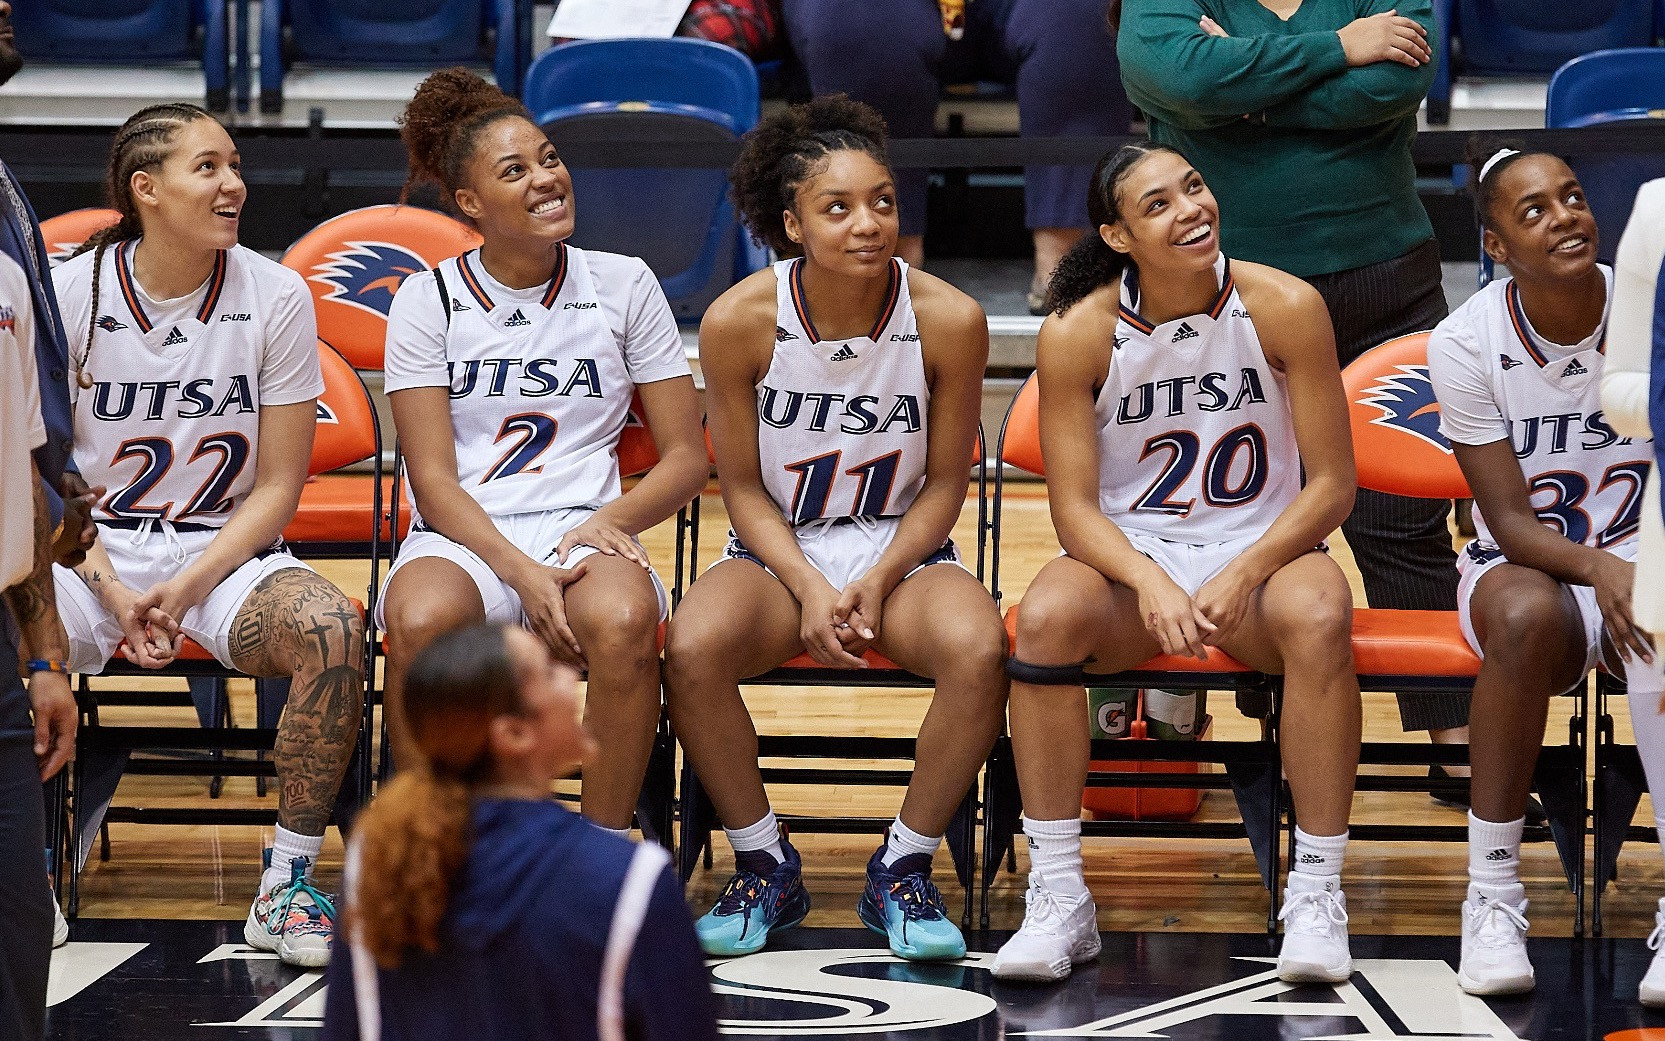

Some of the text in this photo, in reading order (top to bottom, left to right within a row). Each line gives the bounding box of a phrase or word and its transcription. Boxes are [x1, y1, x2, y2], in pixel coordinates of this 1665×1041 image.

[161, 336, 188, 347] adidas
[1171, 330, 1199, 343] adidas
[448, 358, 604, 399] UTSA
[1117, 367, 1268, 425] UTSA
[1560, 366, 1588, 378] adidas
[92, 374, 256, 422] UTSA
[760, 386, 922, 435] UTSA
[478, 411, 558, 485] 2
[1510, 410, 1655, 460] UTS
[101, 431, 250, 521] 22
[784, 449, 902, 526] 11
[1129, 421, 1269, 518] 20
[1528, 460, 1652, 550] 32
[1097, 701, 1126, 735] G
[284, 781, 304, 804] 100
